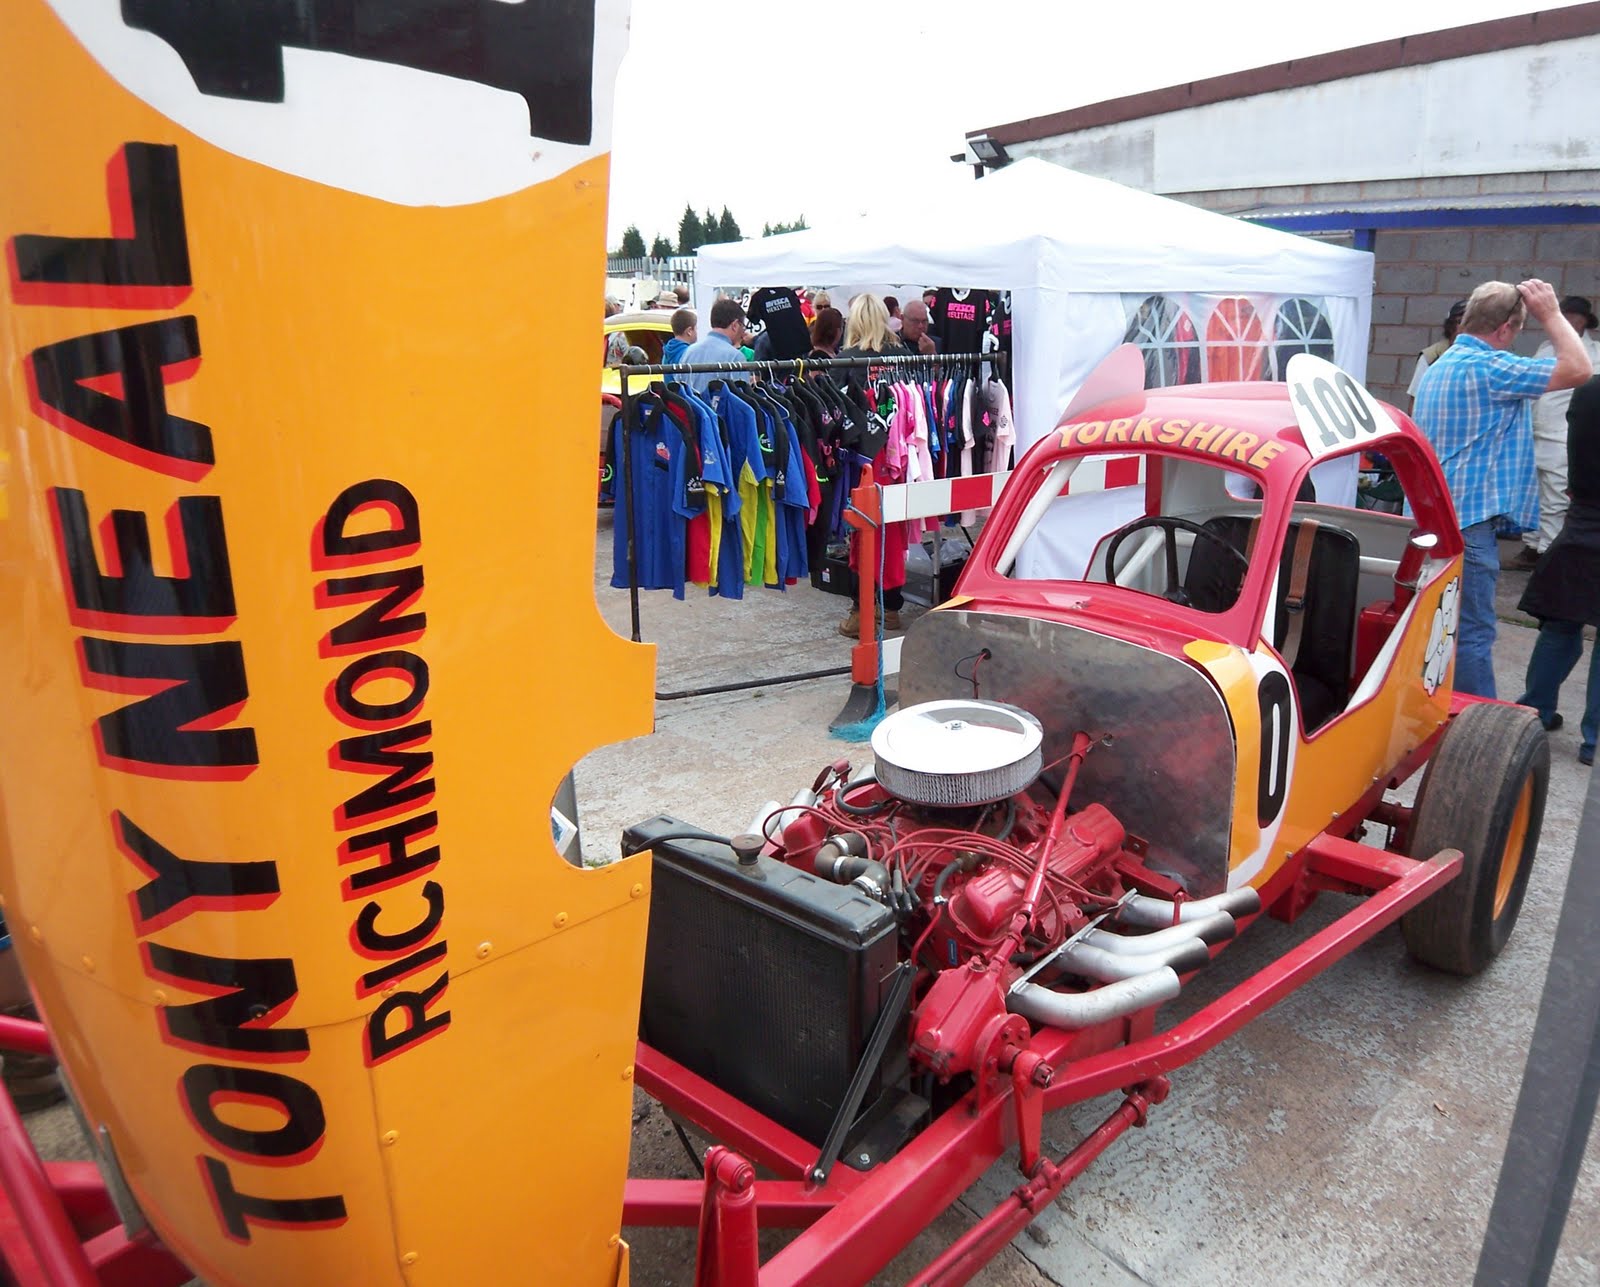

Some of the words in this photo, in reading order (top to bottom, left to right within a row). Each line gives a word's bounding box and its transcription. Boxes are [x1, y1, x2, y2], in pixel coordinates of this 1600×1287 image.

[766, 302, 793, 313] HERITAGE
[947, 312, 975, 321] HERITAGE
[5, 140, 261, 782] NEAL
[1058, 417, 1287, 470] YORKSHIRE
[1294, 371, 1376, 447] 100
[311, 478, 450, 1069] RICHMOND
[1258, 670, 1292, 829] 0
[110, 809, 348, 1245] TONY
